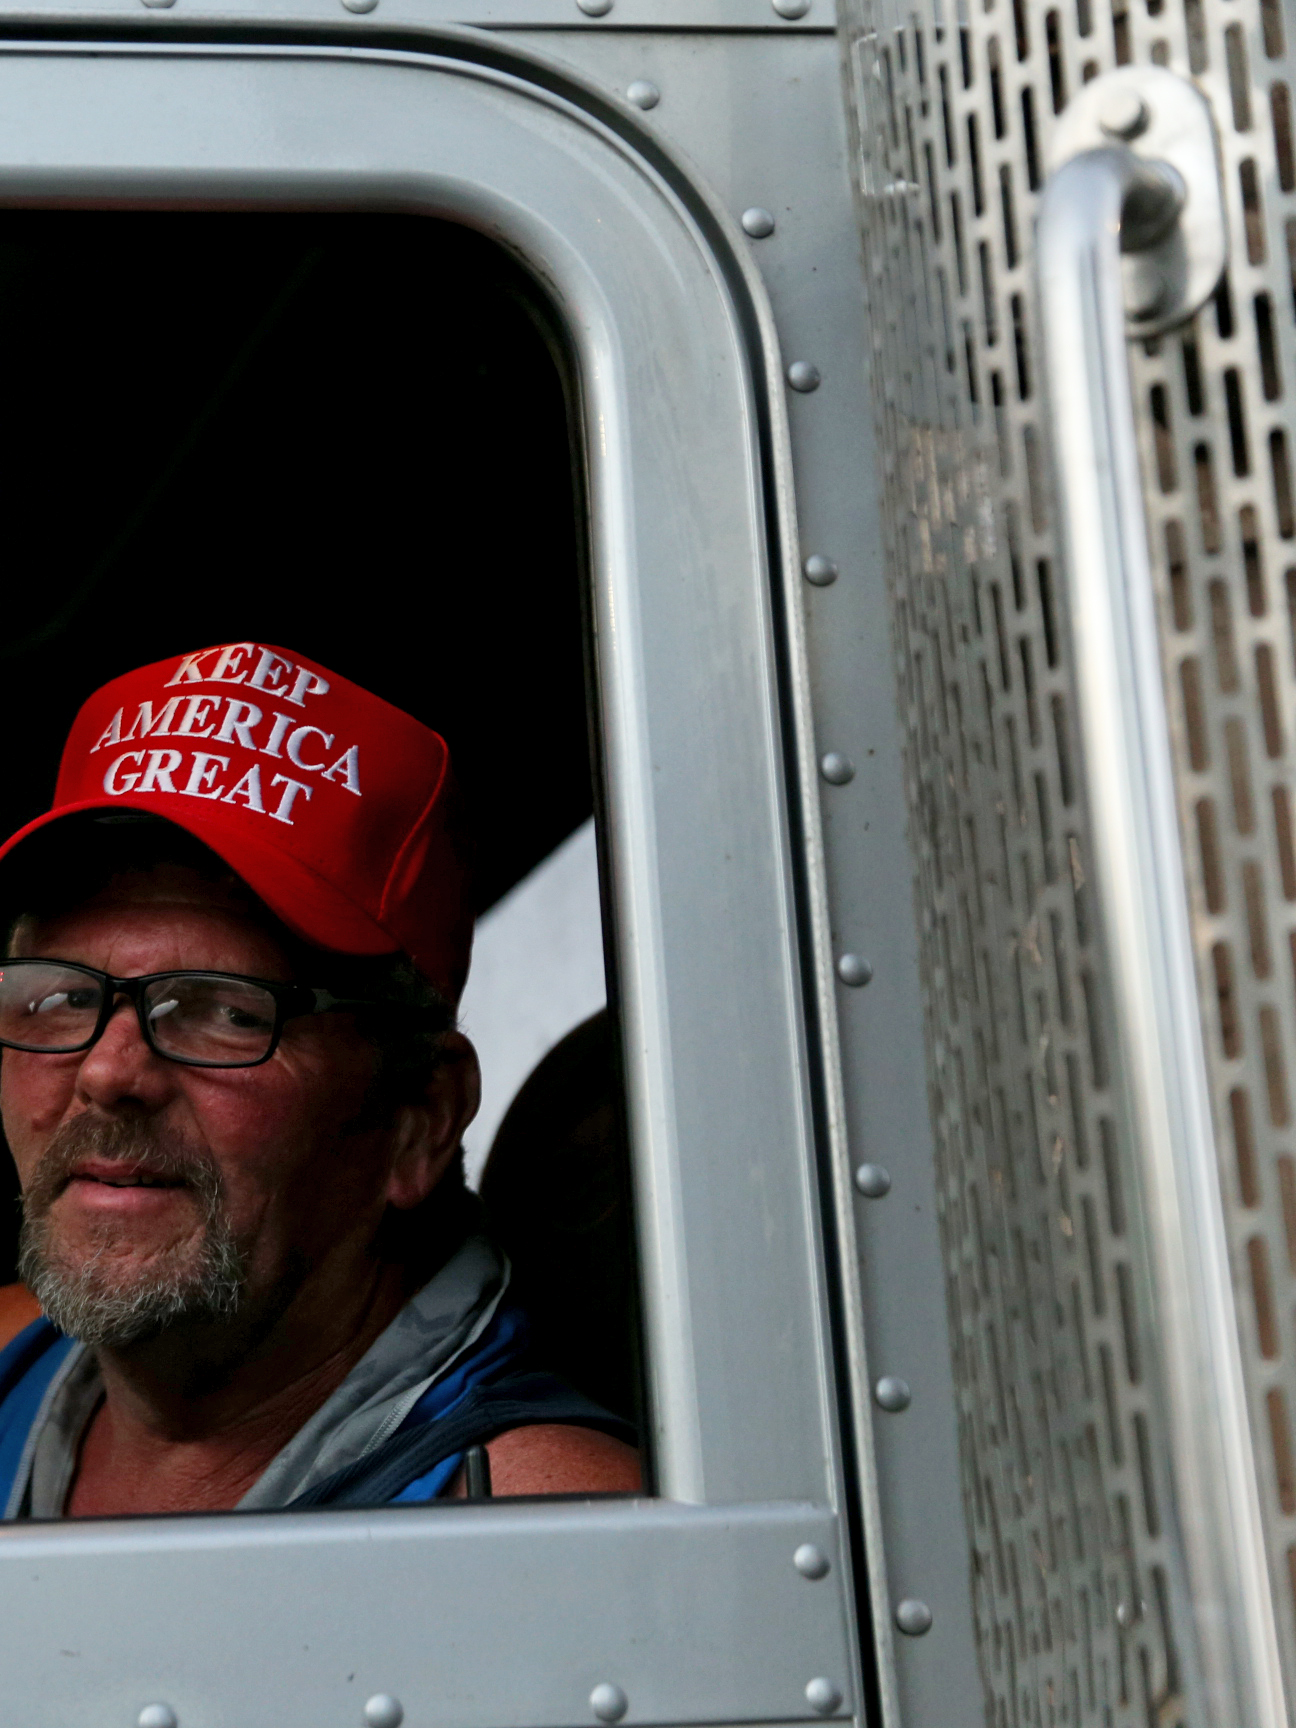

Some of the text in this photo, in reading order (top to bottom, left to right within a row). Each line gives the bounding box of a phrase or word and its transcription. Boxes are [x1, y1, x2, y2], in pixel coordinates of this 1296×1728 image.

[163, 642, 331, 708] KEEP
[89, 694, 363, 797] AMERICA
[103, 748, 315, 826] GREAT
